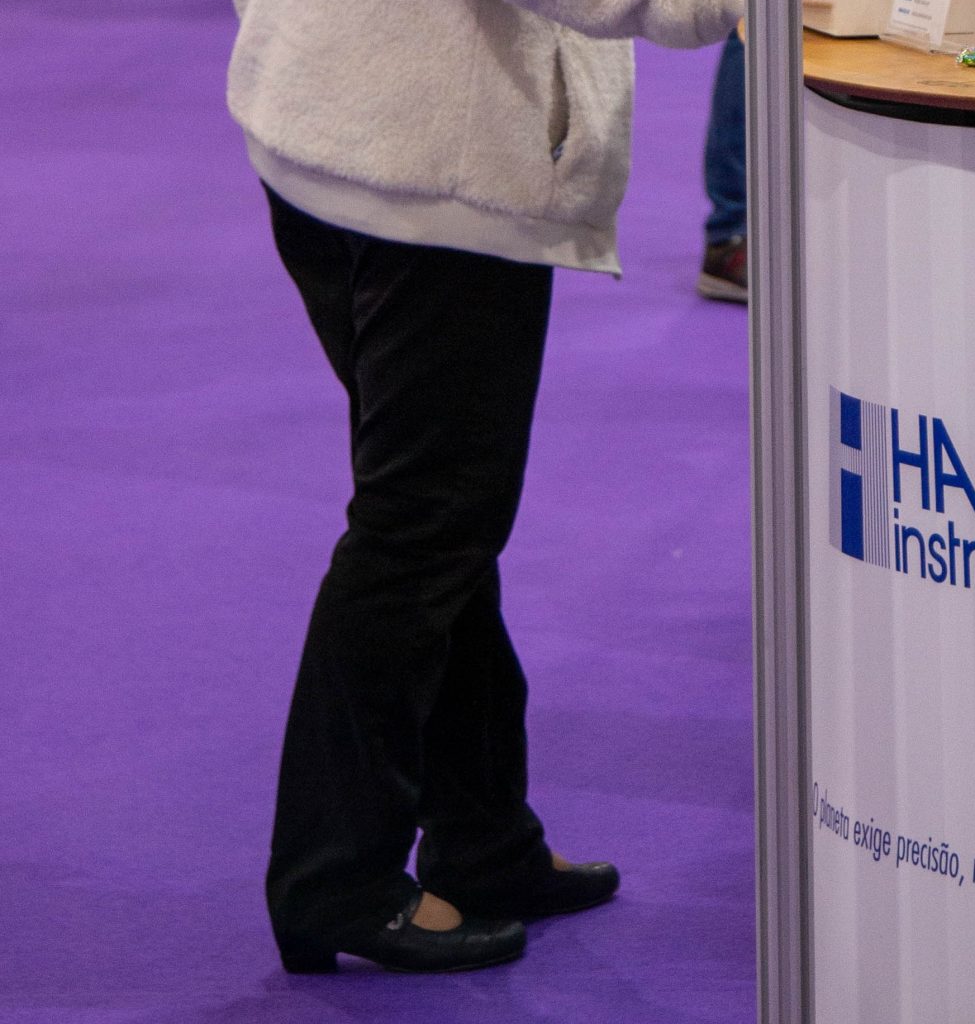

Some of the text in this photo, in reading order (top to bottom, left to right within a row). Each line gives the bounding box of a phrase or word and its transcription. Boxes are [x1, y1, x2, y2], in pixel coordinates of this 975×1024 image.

[820, 788, 850, 841] planeta
[853, 817, 891, 862] exige
[896, 837, 965, 887] precisão,
